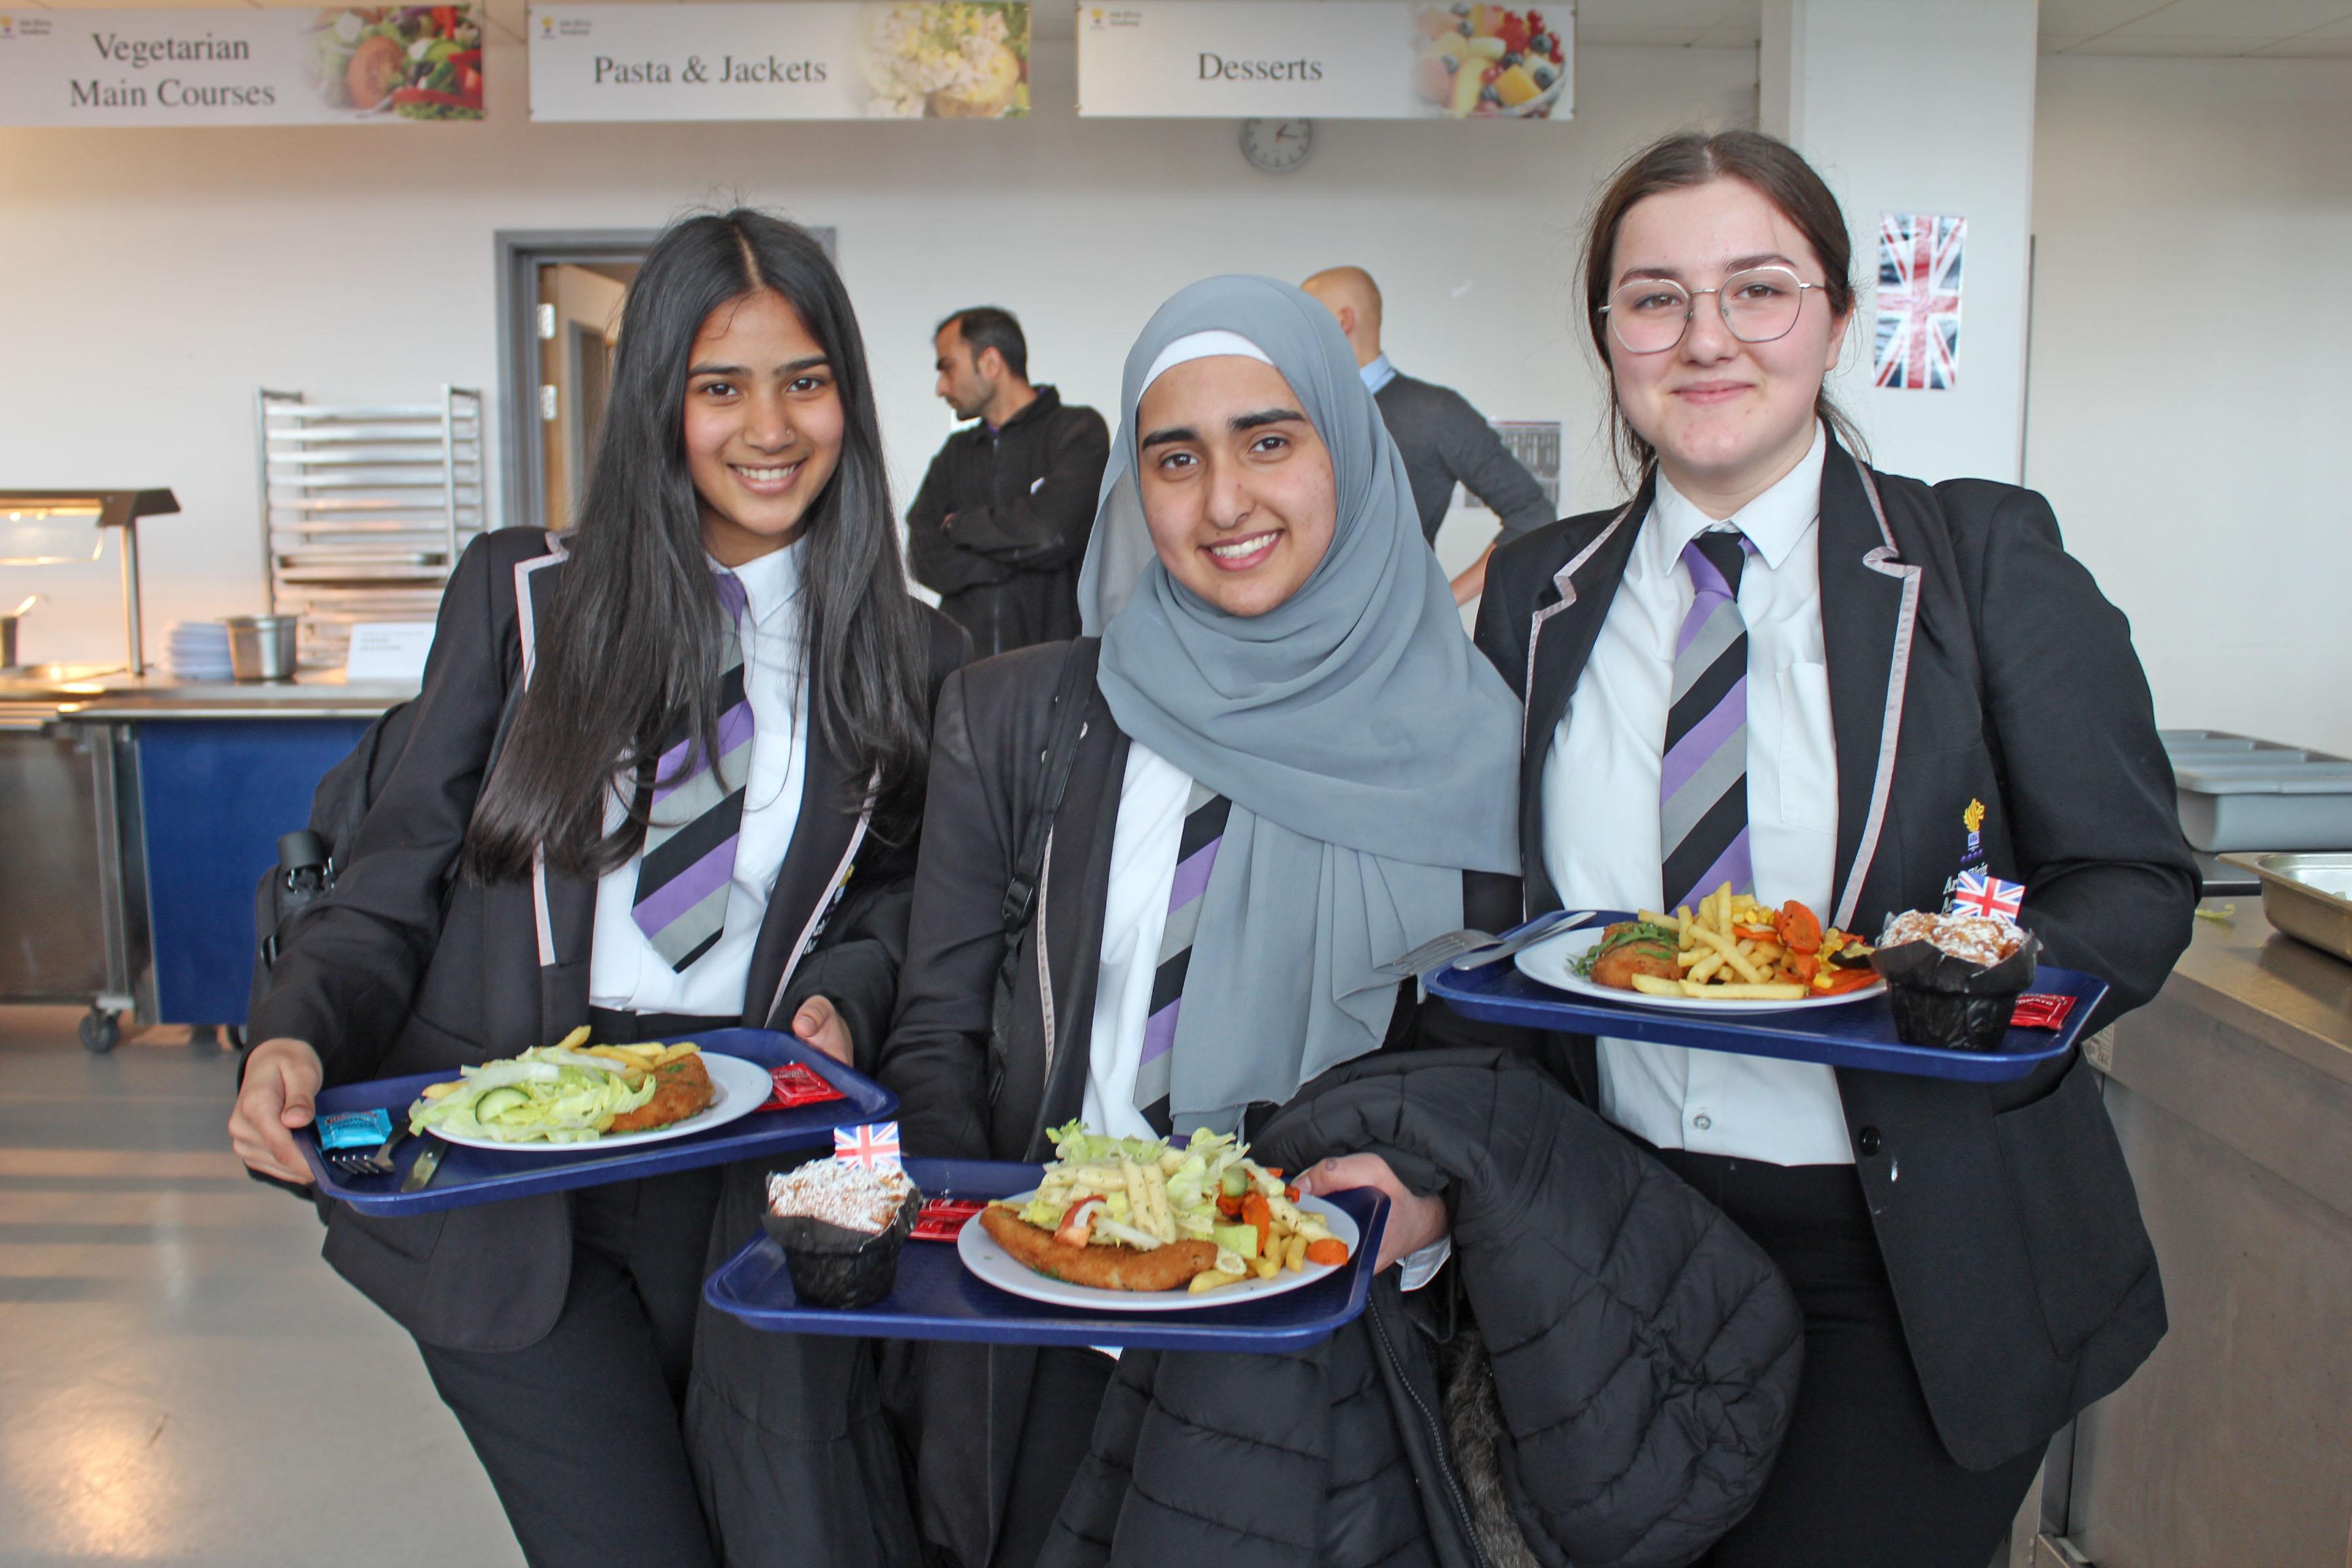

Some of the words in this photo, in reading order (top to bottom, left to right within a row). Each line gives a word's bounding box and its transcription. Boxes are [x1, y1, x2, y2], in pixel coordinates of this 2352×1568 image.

[93, 33, 250, 69] Vegetarian
[594, 56, 672, 84] Pasta
[681, 56, 708, 84] &
[719, 55, 827, 83] Jackets
[1198, 52, 1322, 81] Desserts
[70, 79, 147, 107] Main
[157, 78, 276, 107] Courses
